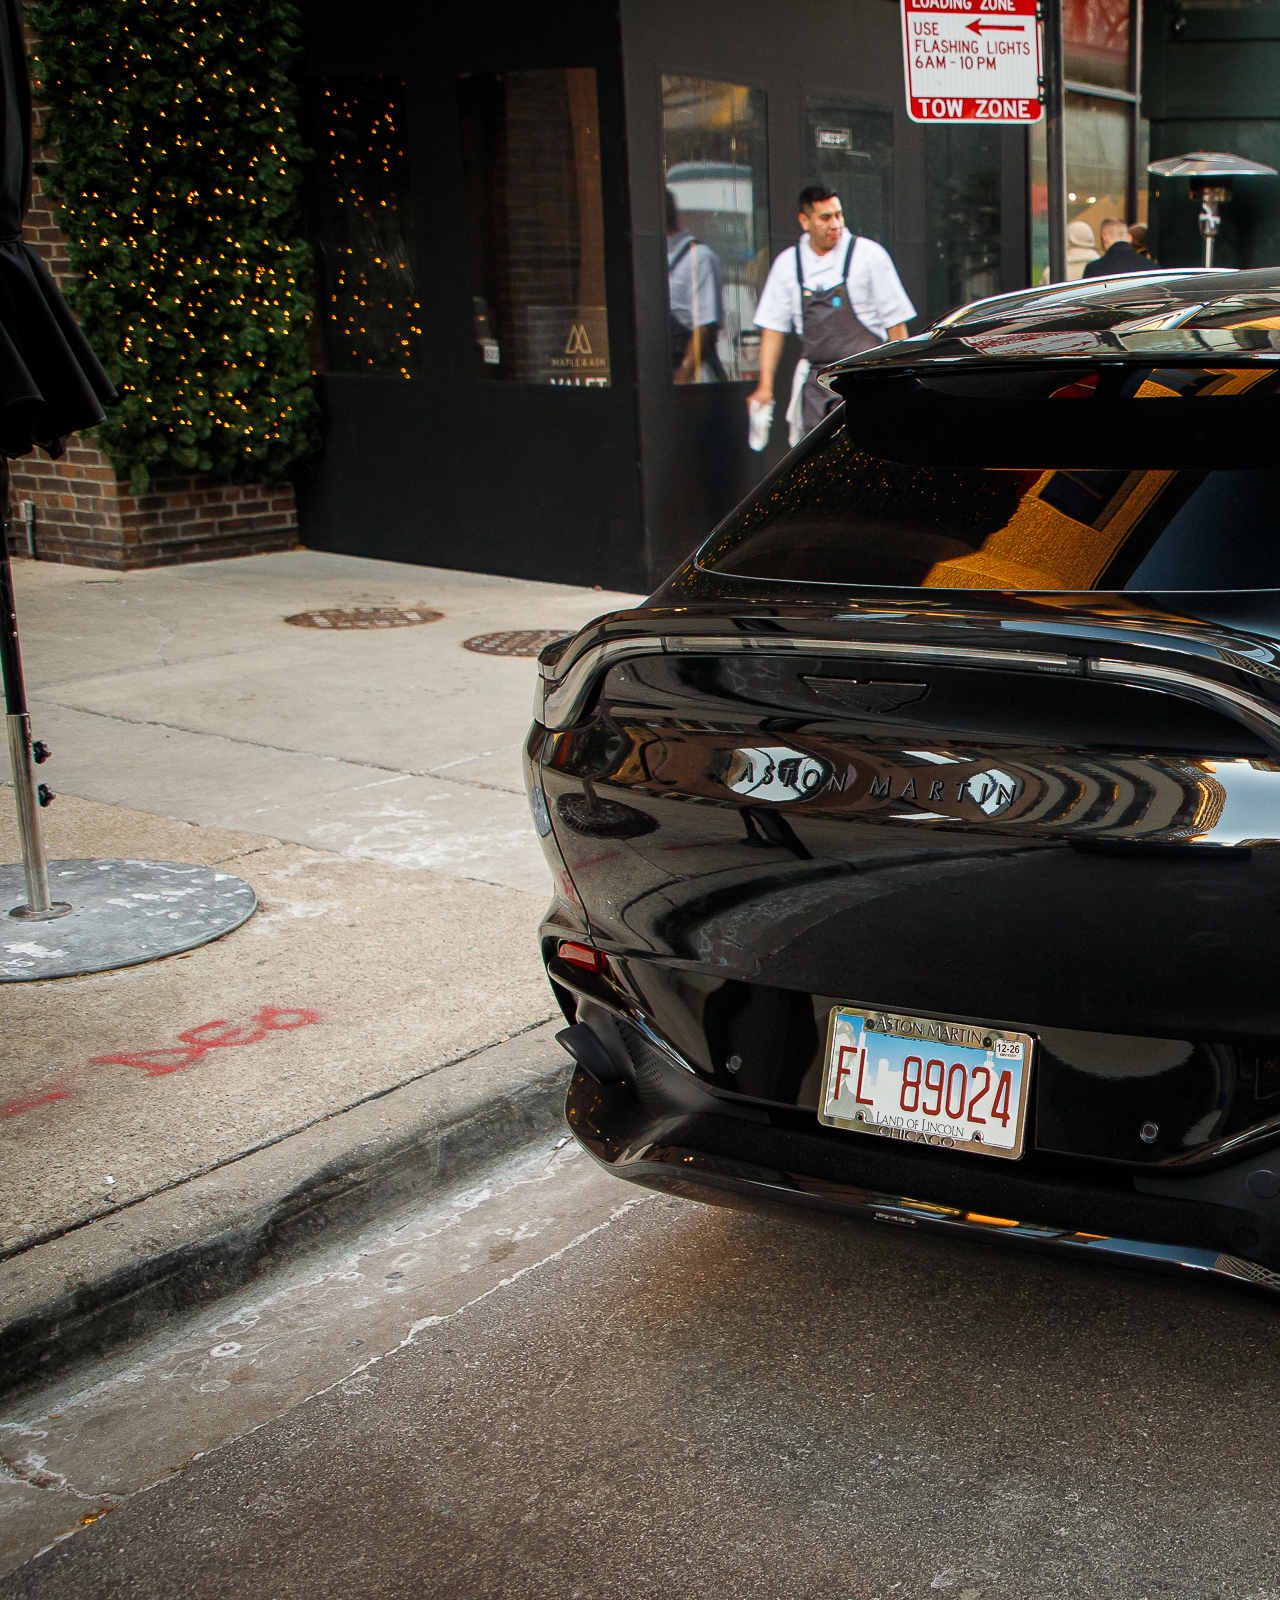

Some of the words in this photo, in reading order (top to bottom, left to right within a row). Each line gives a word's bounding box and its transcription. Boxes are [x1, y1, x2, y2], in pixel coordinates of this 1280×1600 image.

[911, 0, 972, 11] LOADING
[979, 0, 1016, 12] ZONE
[913, 22, 940, 36] USE
[915, 39, 979, 54] FLASHING
[987, 41, 1031, 55] LIGHTS
[918, 99, 964, 118] TOW
[974, 99, 1031, 119] ZONE
[737, 761, 849, 795] ASTON
[869, 775, 1017, 807] MARTIN
[876, 1015, 924, 1035] ASTON
[928, 1023, 984, 1045] MARTIN
[997, 1043, 1020, 1054] 12-26
[833, 1045, 874, 1105] FL
[900, 1055, 1012, 1128] 89024
[876, 1111, 904, 1127] LAND
[907, 1118, 919, 1130] OF
[922, 1118, 964, 1137] LINCOLN
[878, 1125, 956, 1148] CHICAGO
